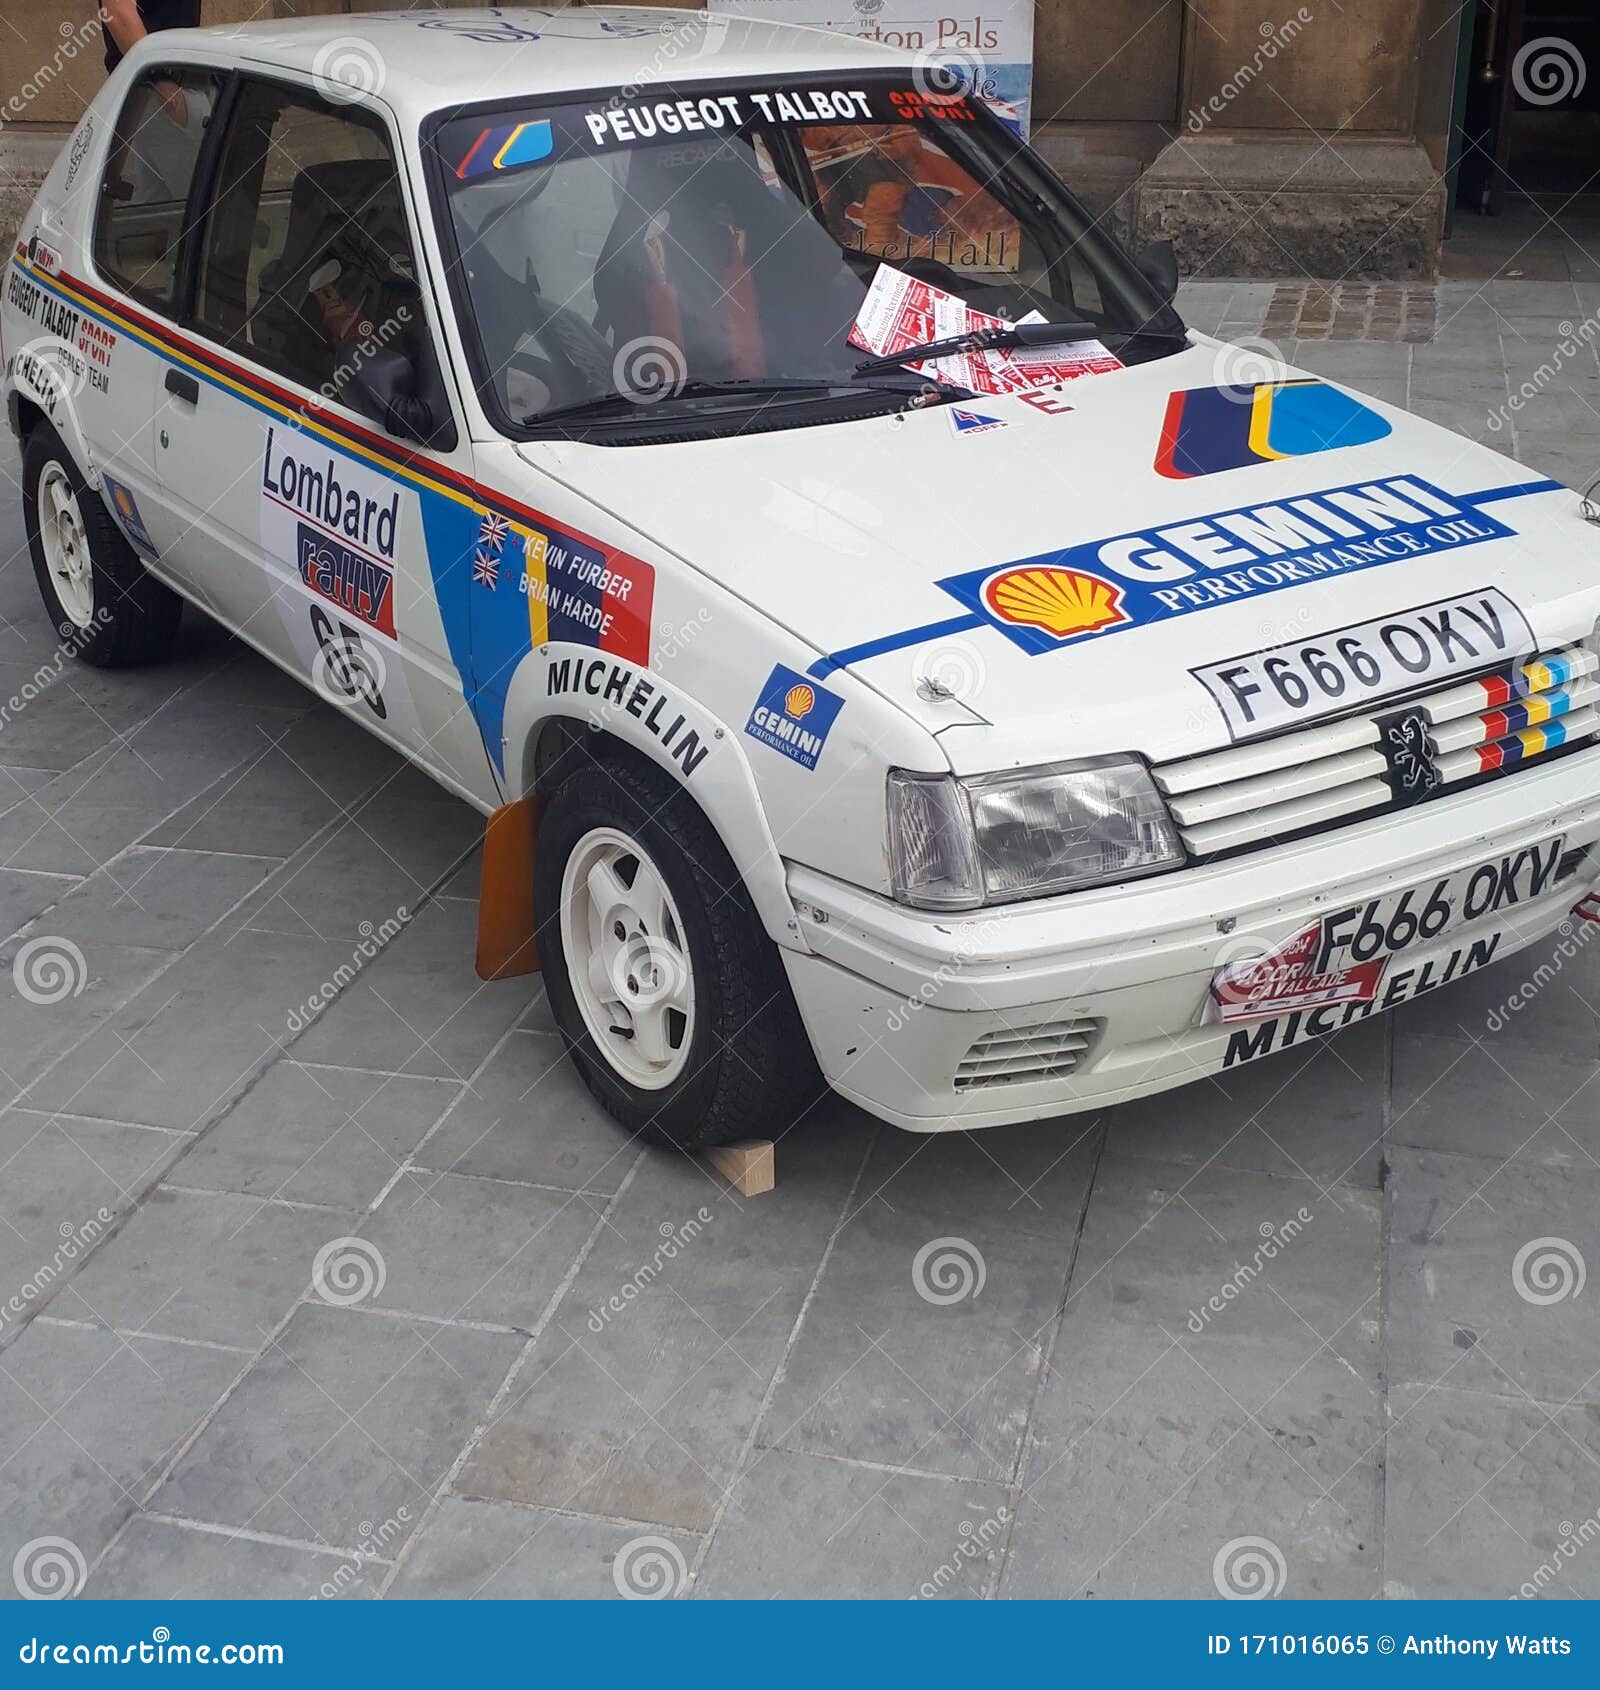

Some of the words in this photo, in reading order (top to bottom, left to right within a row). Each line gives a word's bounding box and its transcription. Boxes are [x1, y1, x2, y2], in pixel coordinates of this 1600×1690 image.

[938, 16, 998, 49] Pals
[585, 96, 744, 145] PEUGEOT
[751, 91, 873, 123] TALBOT
[888, 91, 976, 120] SPORT
[929, 230, 1006, 266] Hall
[8, 271, 40, 320] PEUGEOT
[40, 294, 79, 343] TALBOT
[79, 319, 116, 368] SPORT
[88, 366, 109, 394] TEAM
[263, 427, 399, 558] Lombard
[1098, 480, 1462, 583] GEMINI
[302, 537, 391, 623] rally
[518, 572, 561, 609] BRIAN
[561, 593, 614, 636] HARDE
[522, 535, 568, 570] KEVIN
[567, 555, 633, 602] FURBER
[1149, 531, 1427, 611] PERFORMANCE
[1425, 519, 1496, 544] OIL
[309, 604, 387, 720] 65
[1216, 638, 1381, 722] F666
[1380, 599, 1507, 673] OKV
[547, 659, 708, 777] MICHELIN
[748, 724, 799, 759] PERFORMANCE
[799, 753, 813, 766] OIL
[753, 706, 822, 757] GEMINI
[1314, 879, 1451, 975] F666
[1463, 840, 1562, 920] OKV
[1222, 933, 1501, 1068] MICHELIN
[1248, 970, 1349, 1000] CAVALCADE
